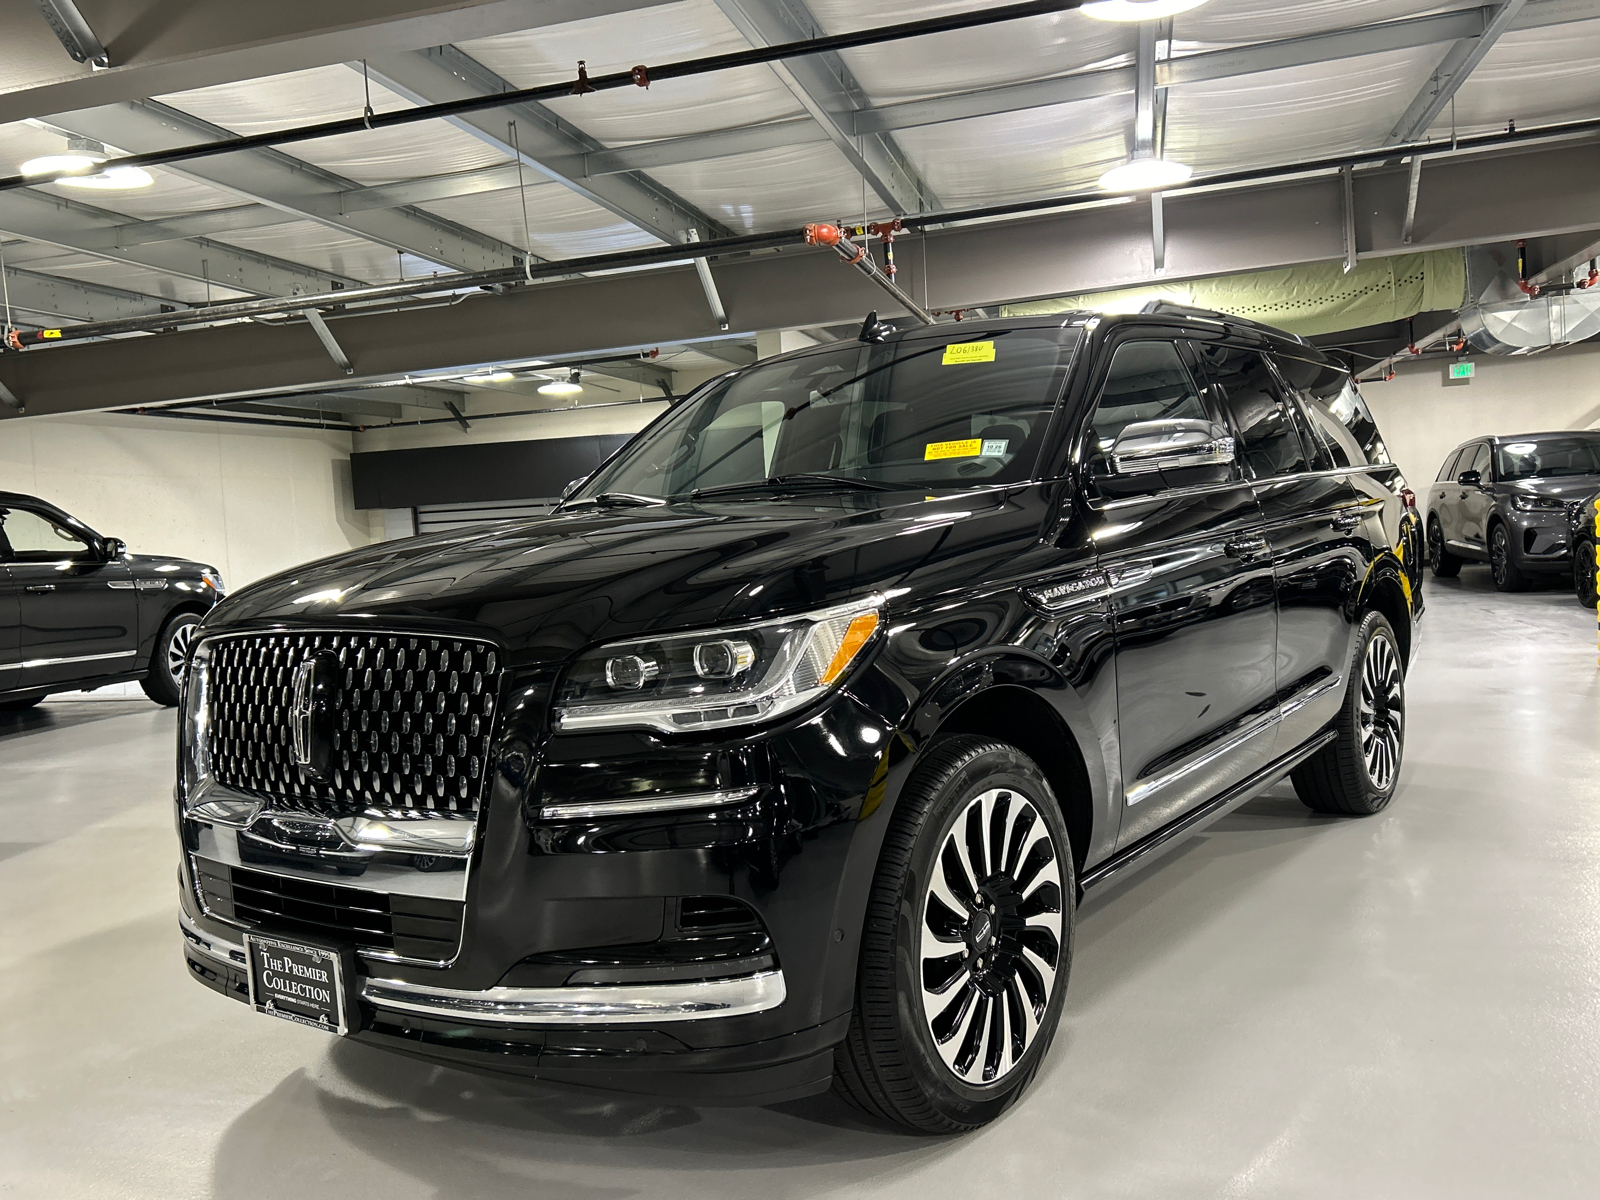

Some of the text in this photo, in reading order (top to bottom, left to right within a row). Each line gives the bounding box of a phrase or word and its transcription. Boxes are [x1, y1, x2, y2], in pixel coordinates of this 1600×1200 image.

[1453, 363, 1472, 378] EXIT
[1043, 575, 1105, 599] NAVIGATOR
[260, 951, 329, 983] THE PREMIER
[262, 970, 331, 1004] COLLECTION
[274, 993, 297, 1003] EVERYTHING
